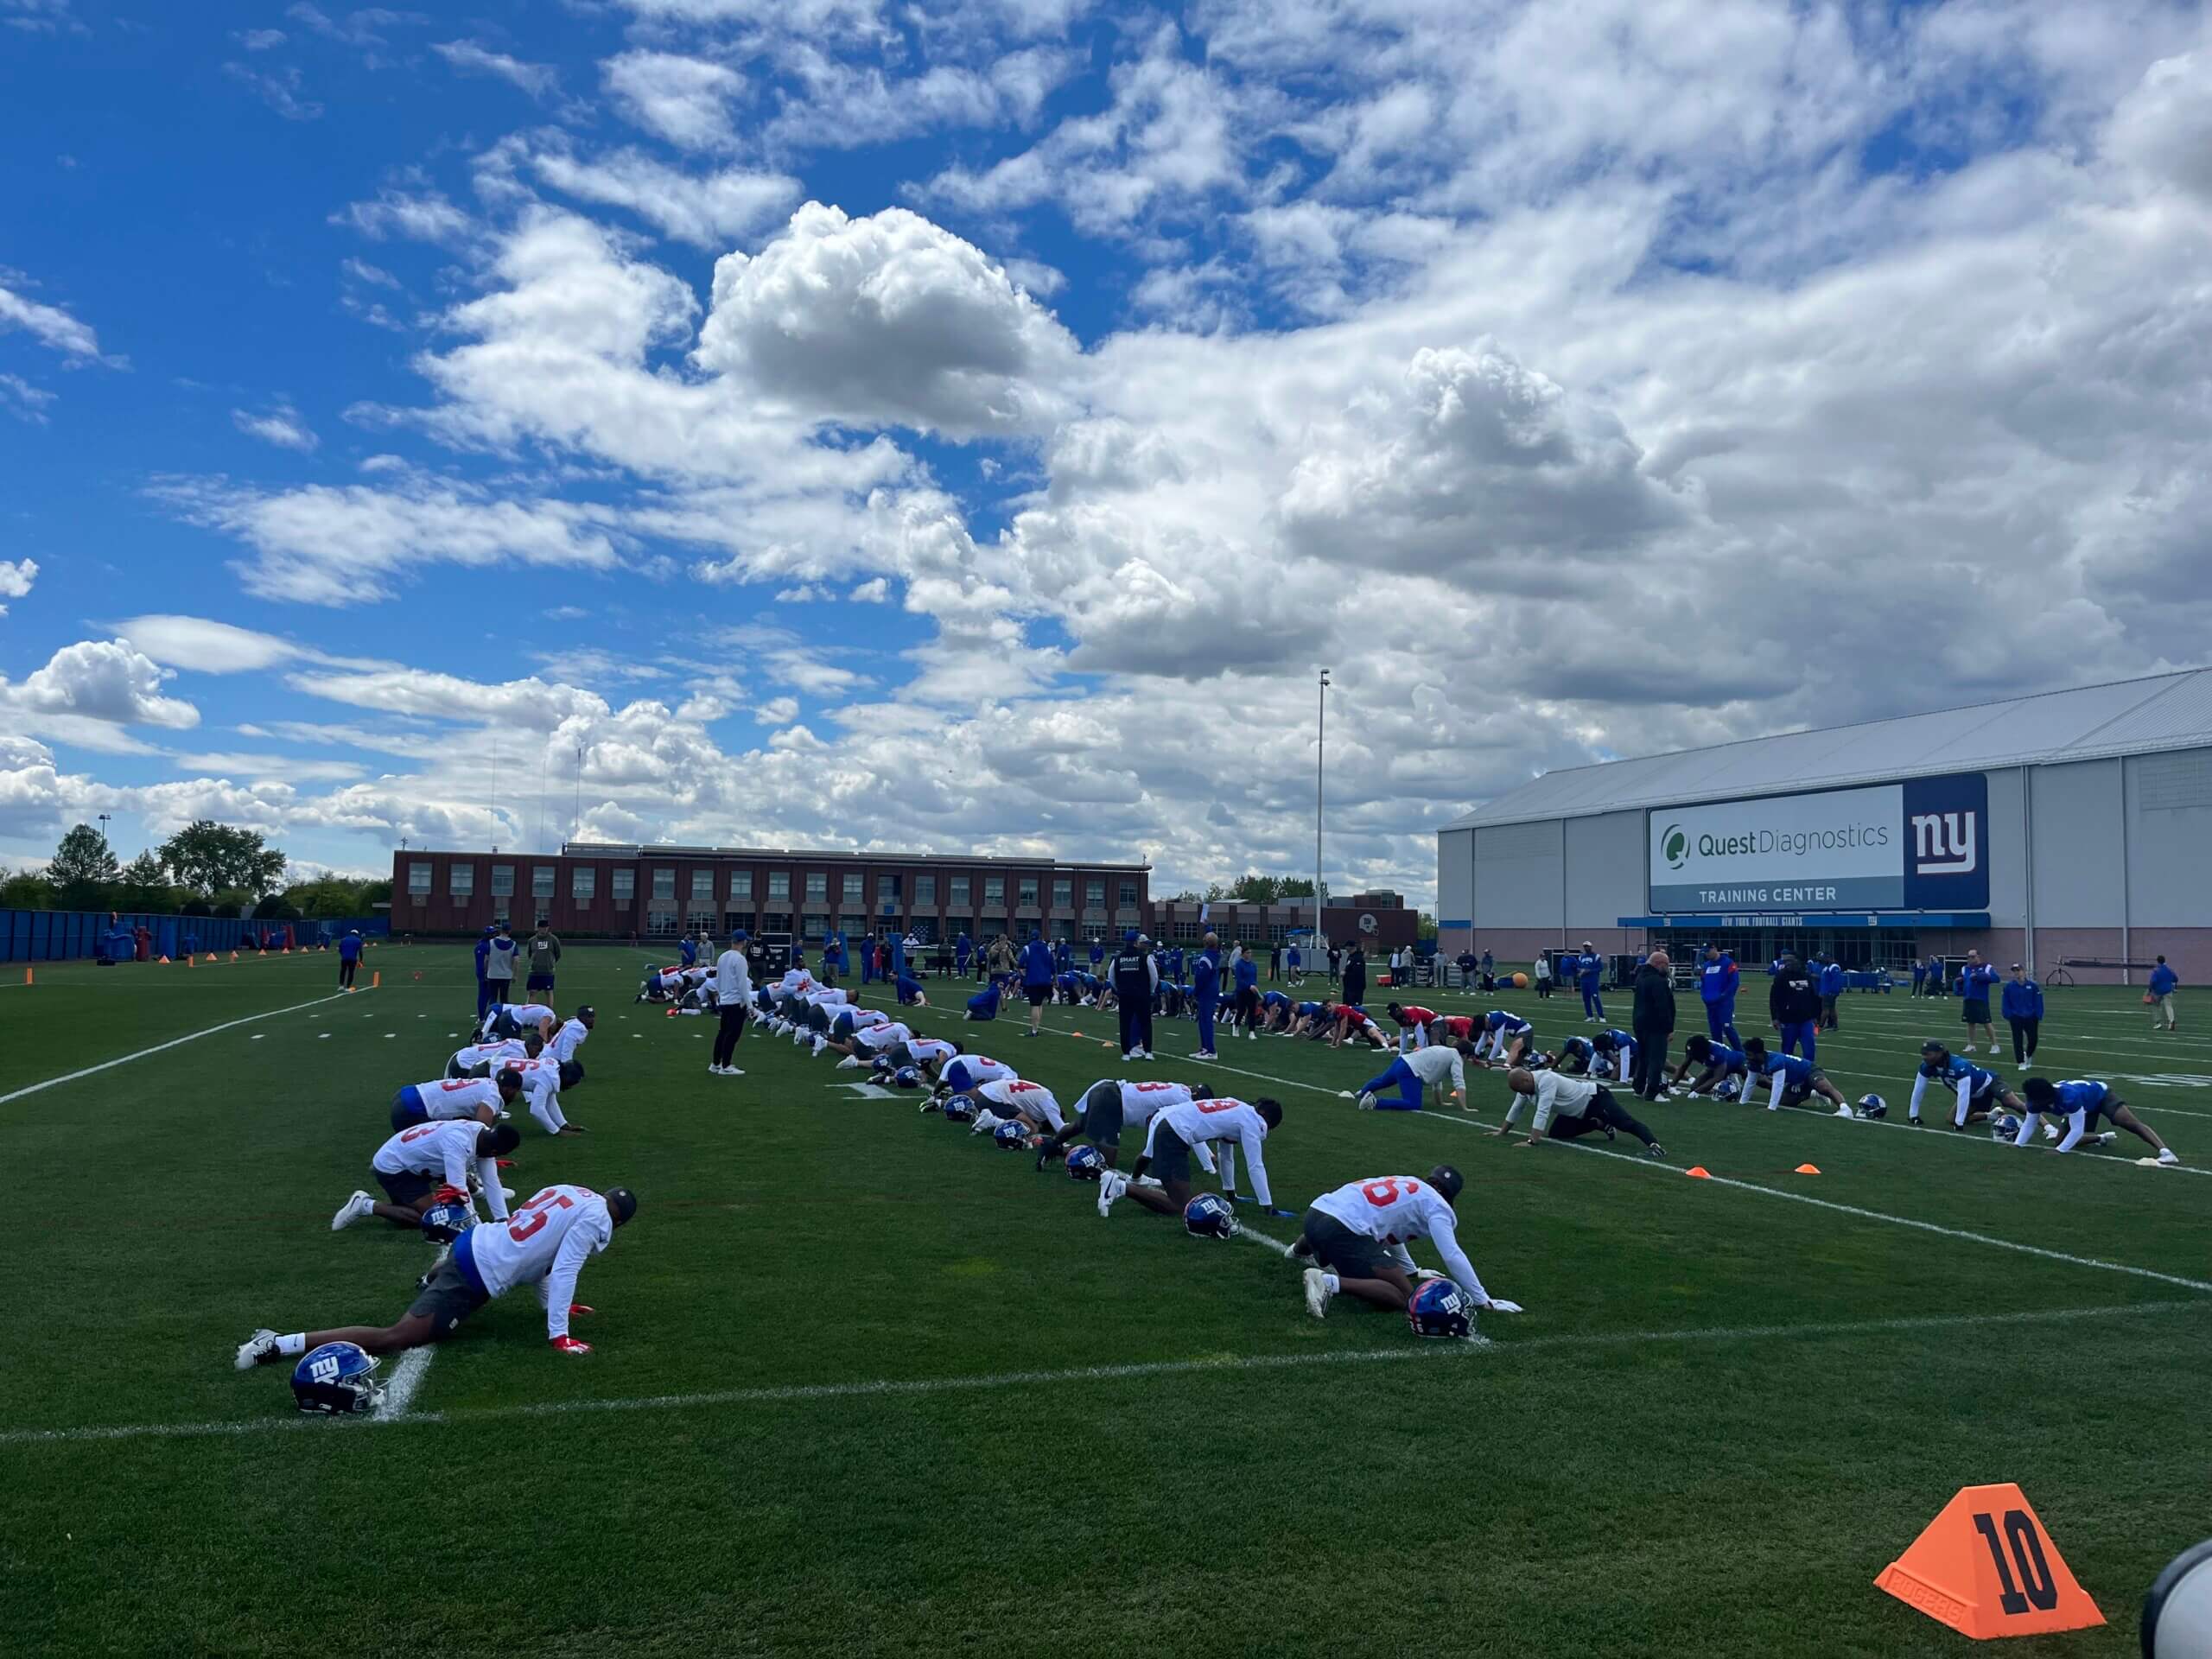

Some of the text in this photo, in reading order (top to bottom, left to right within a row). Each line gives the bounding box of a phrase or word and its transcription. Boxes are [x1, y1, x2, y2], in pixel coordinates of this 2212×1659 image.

[1699, 887, 1837, 903] TRAINING CENTER
[1721, 916, 1802, 926] NEW YORK FOOTBALL GIANTS
[1973, 1510, 2058, 1615] 10
